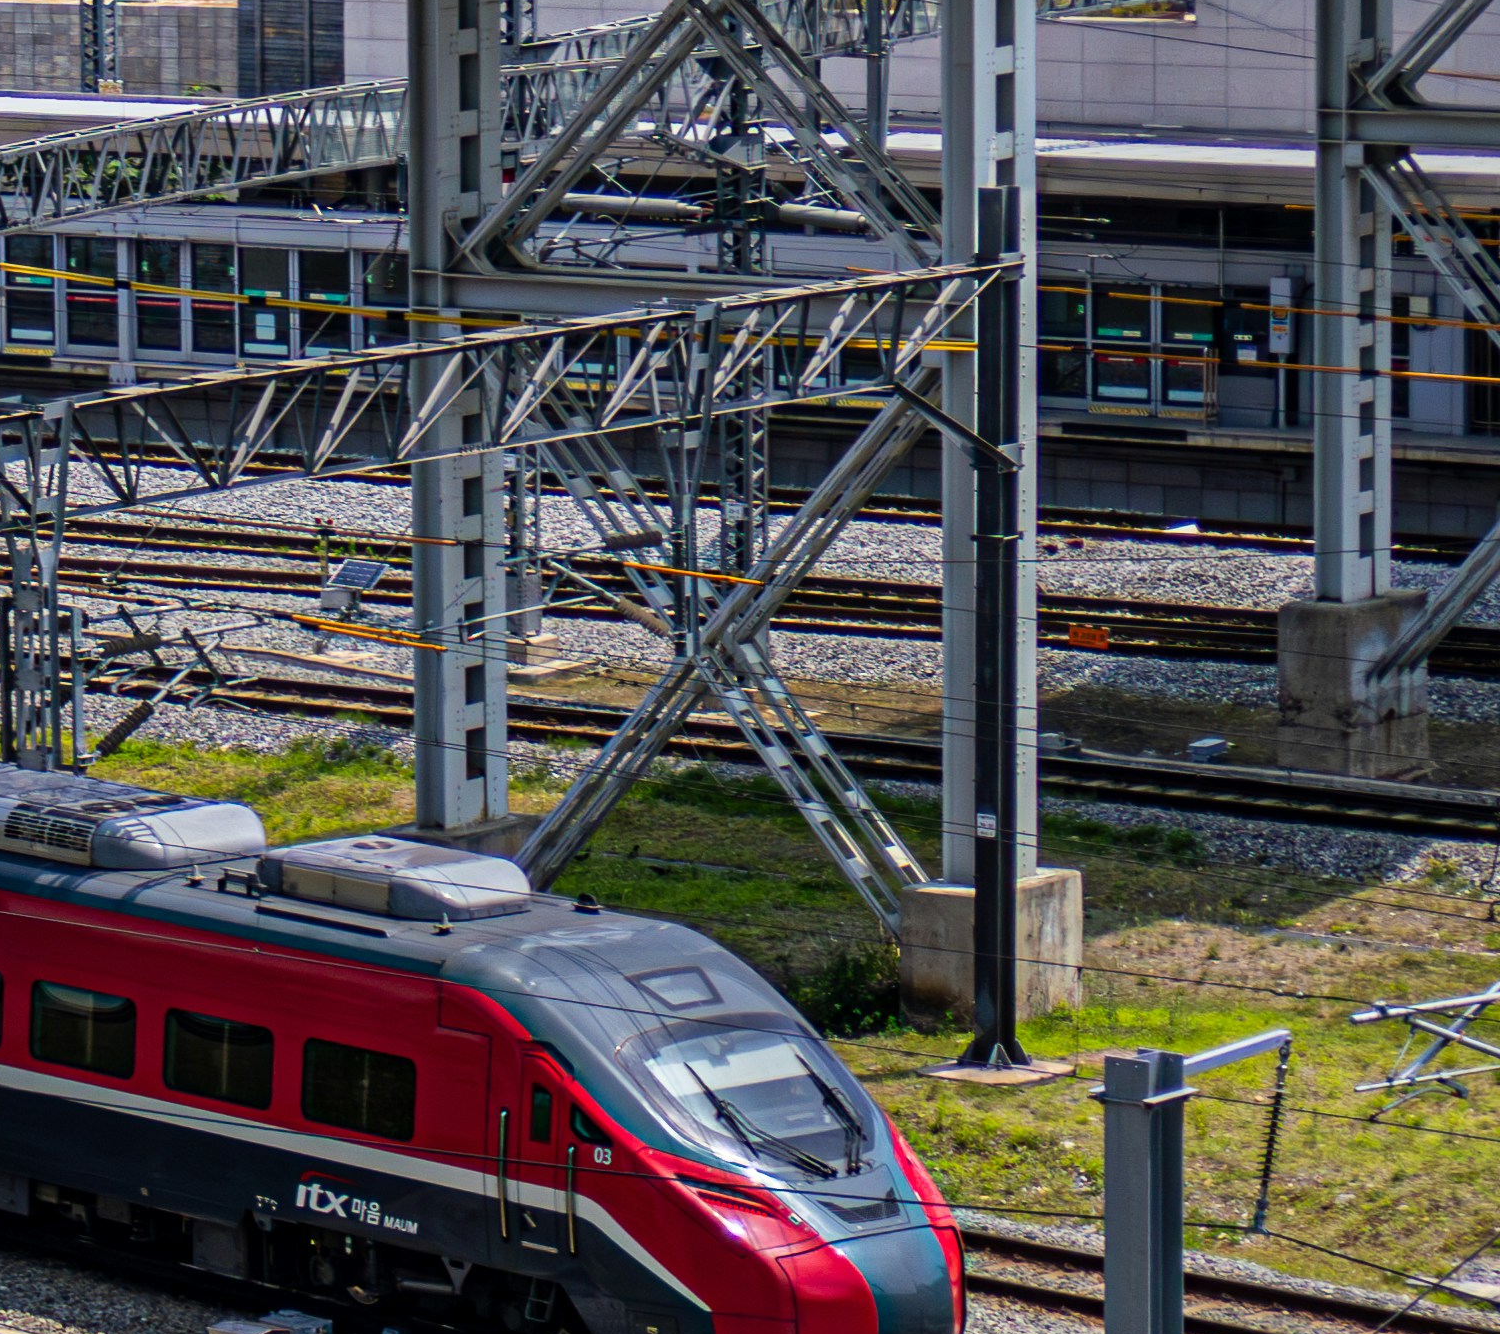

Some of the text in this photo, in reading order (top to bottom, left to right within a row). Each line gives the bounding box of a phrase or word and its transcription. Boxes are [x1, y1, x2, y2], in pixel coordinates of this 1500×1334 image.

[593, 1146, 612, 1165] 03
[295, 1178, 419, 1235] itx 마음 MAUM
